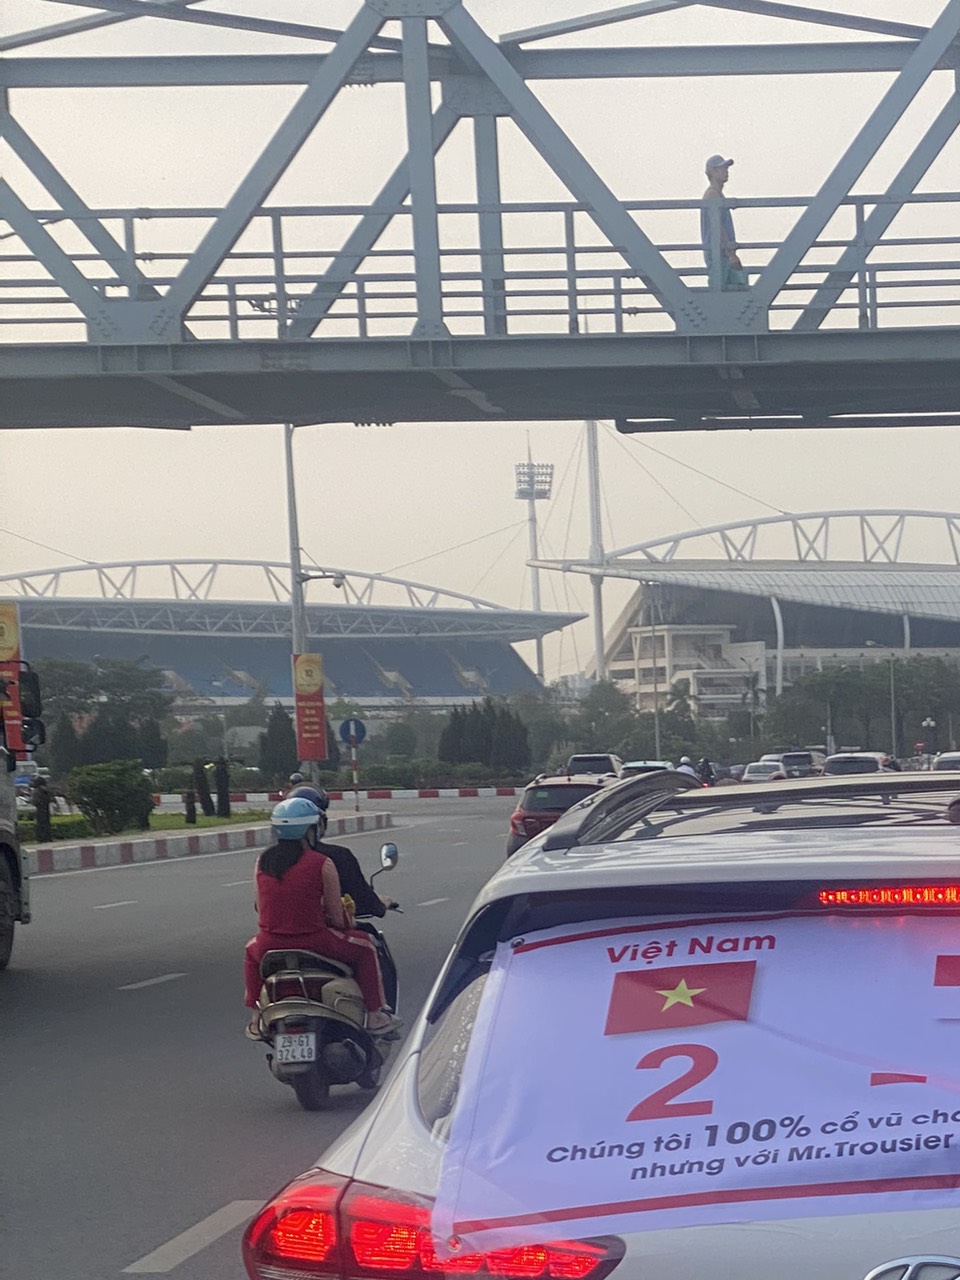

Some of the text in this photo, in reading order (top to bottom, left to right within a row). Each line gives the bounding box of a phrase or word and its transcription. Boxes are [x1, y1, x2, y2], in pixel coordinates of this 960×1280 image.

[606, 934, 776, 965] Việt Nam
[278, 1047, 313, 1061] 324.48
[625, 1043, 719, 1122] 2
[546, 1141, 645, 1163] Chúng
[654, 1133, 692, 1153] tôi
[704, 1115, 811, 1148] 100%
[820, 1111, 860, 1135] cổ
[868, 1112, 903, 1128] vũ
[630, 1157, 726, 1181] nhưng
[735, 1148, 779, 1168] với
